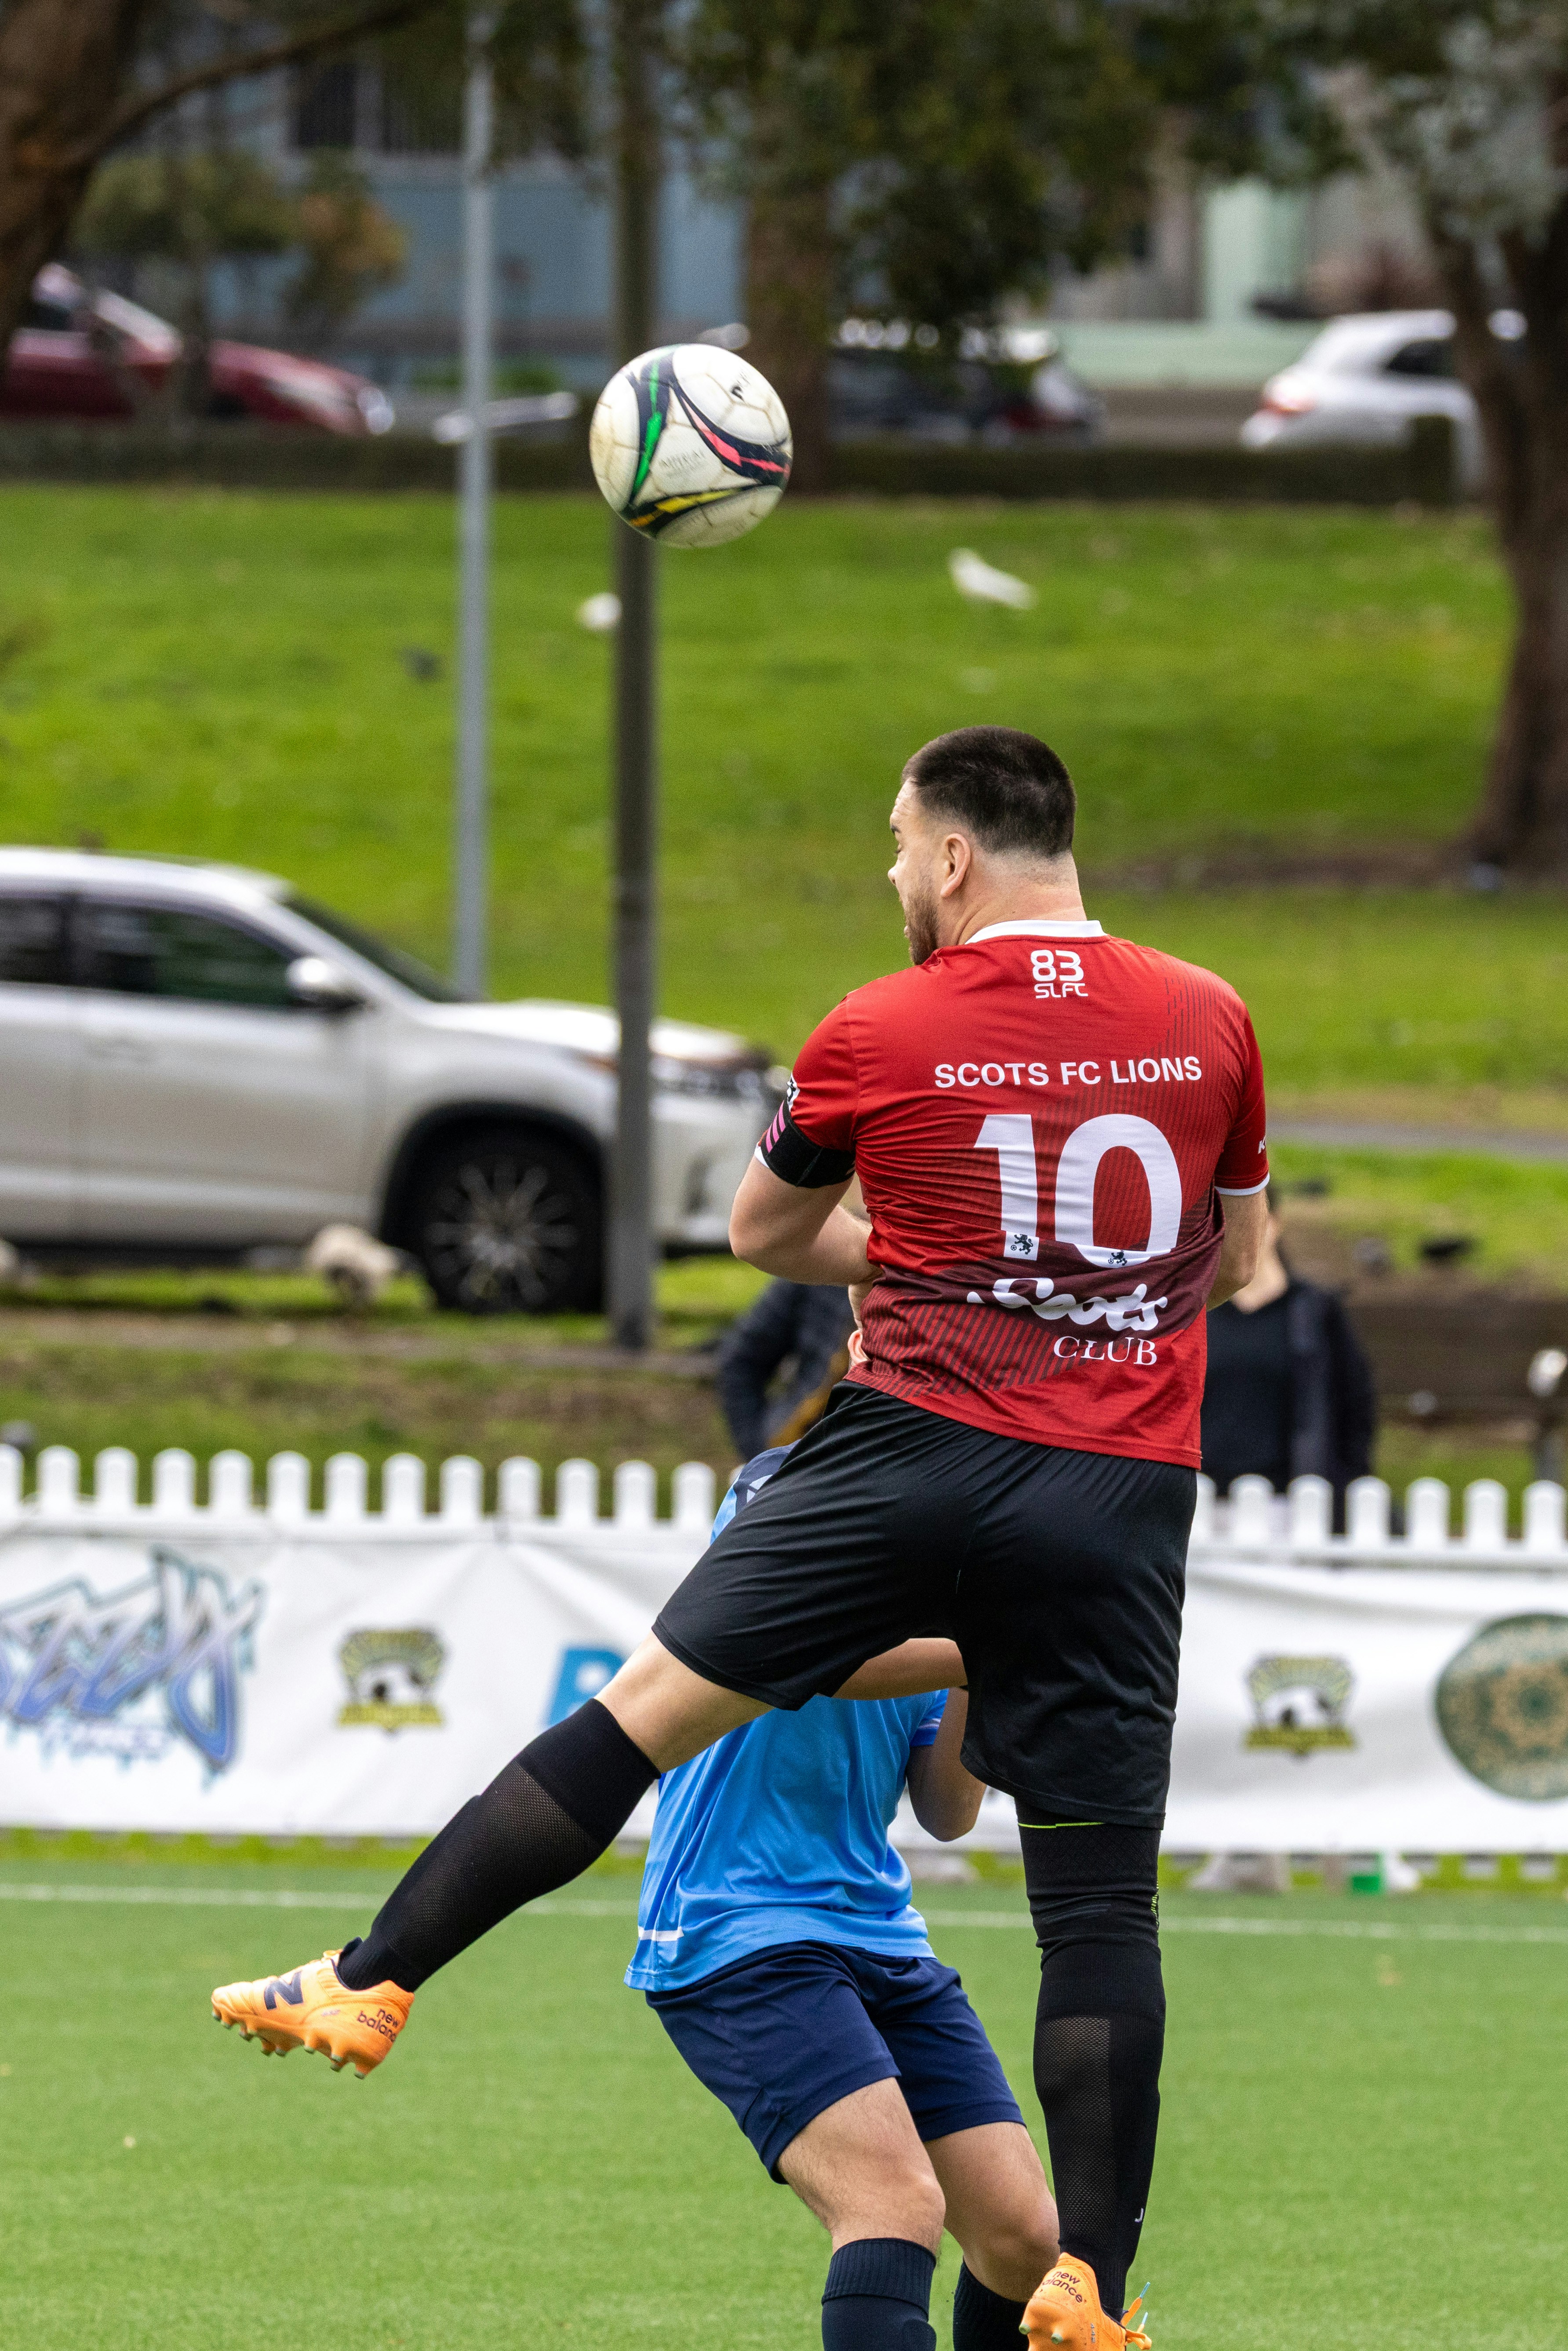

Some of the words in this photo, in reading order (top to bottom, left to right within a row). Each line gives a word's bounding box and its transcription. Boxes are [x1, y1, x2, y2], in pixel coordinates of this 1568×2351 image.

[1030, 949, 1084, 982] 83
[1034, 983, 1089, 999] SLFC
[935, 1063, 1049, 1088] SCOTS
[1060, 1061, 1102, 1085] FC
[1110, 1056, 1202, 1084] LIONS
[973, 1114, 1182, 1269] 10
[1053, 1336, 1157, 1366] CLUB
[1042, 2278, 1083, 2303] alance
[1053, 2271, 1081, 2284] new
